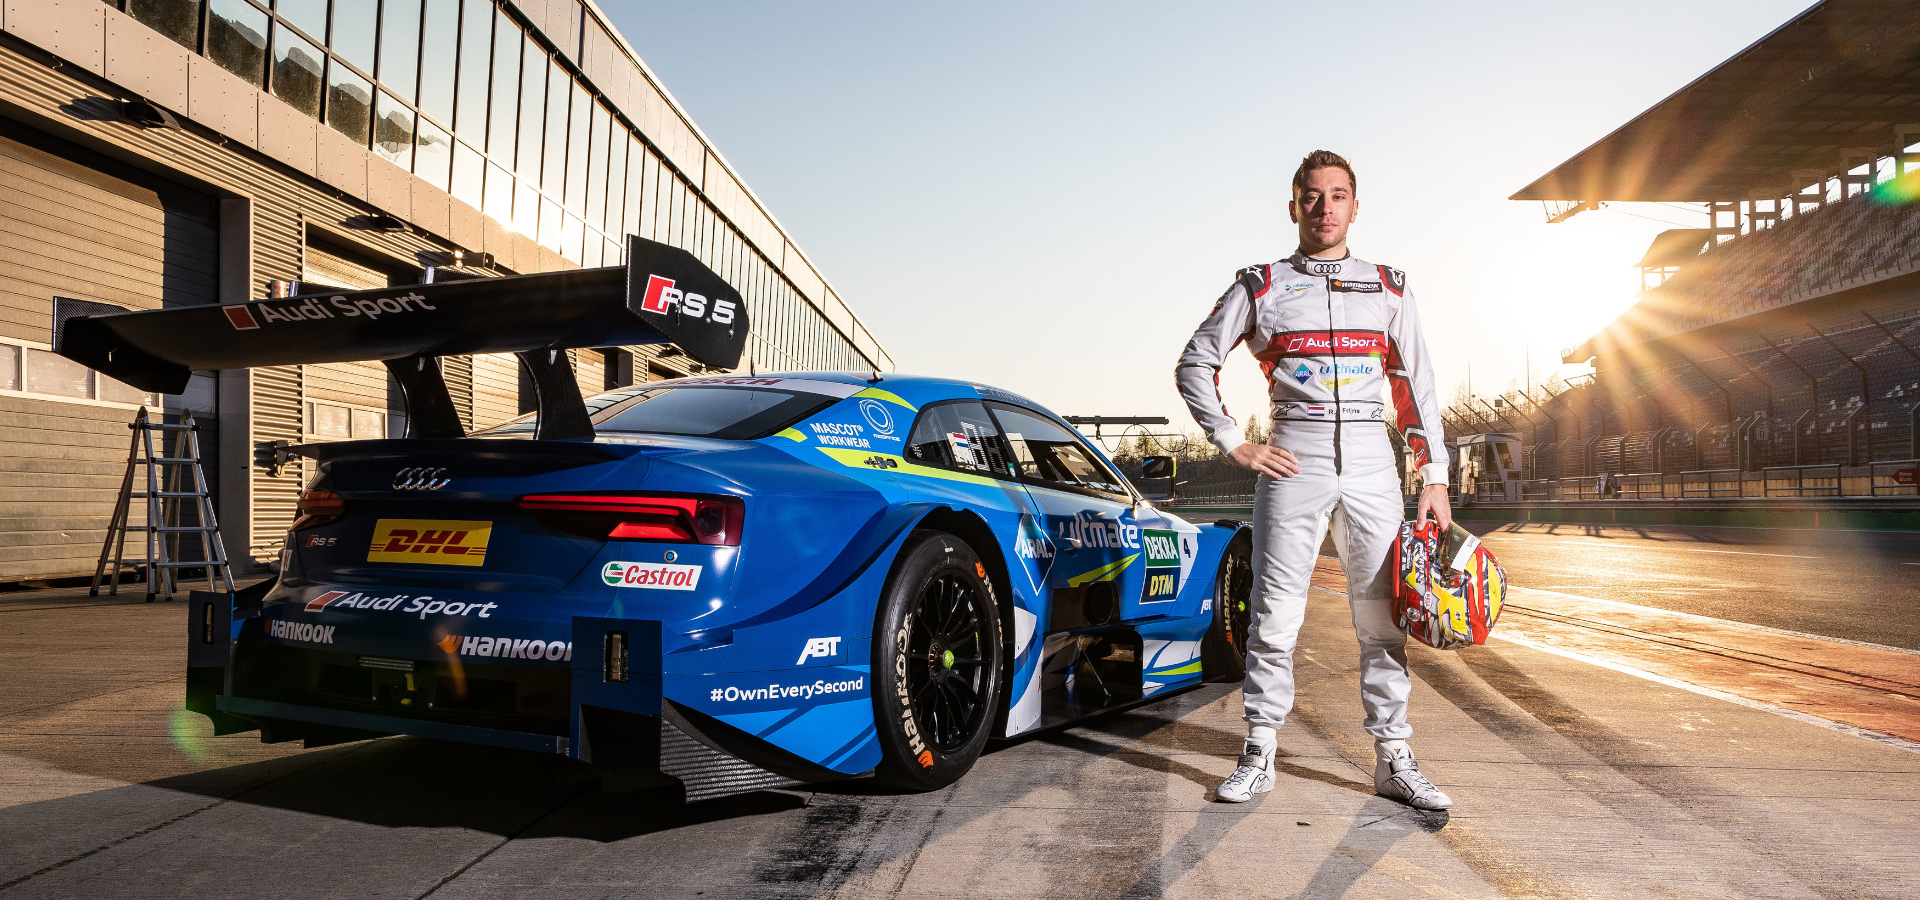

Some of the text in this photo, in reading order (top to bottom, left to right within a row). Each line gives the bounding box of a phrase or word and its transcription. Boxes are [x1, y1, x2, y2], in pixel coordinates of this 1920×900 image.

[257, 291, 437, 323] Audi Sport
[657, 285, 737, 325] RS 5
[1305, 336, 1378, 349] Audi Sport
[816, 434, 872, 449] WORKWEAR
[310, 537, 338, 547] RS 5
[382, 529, 470, 555] DHL
[1144, 535, 1180, 560] DEKRA
[1183, 537, 1192, 559] 4
[624, 565, 695, 587] Castrol
[1149, 574, 1174, 597] DTM
[335, 592, 499, 620] Audi Sport
[1200, 598, 1213, 615] ABT
[796, 636, 842, 666] ABT
[710, 676, 864, 702] #OwnEverySecond
